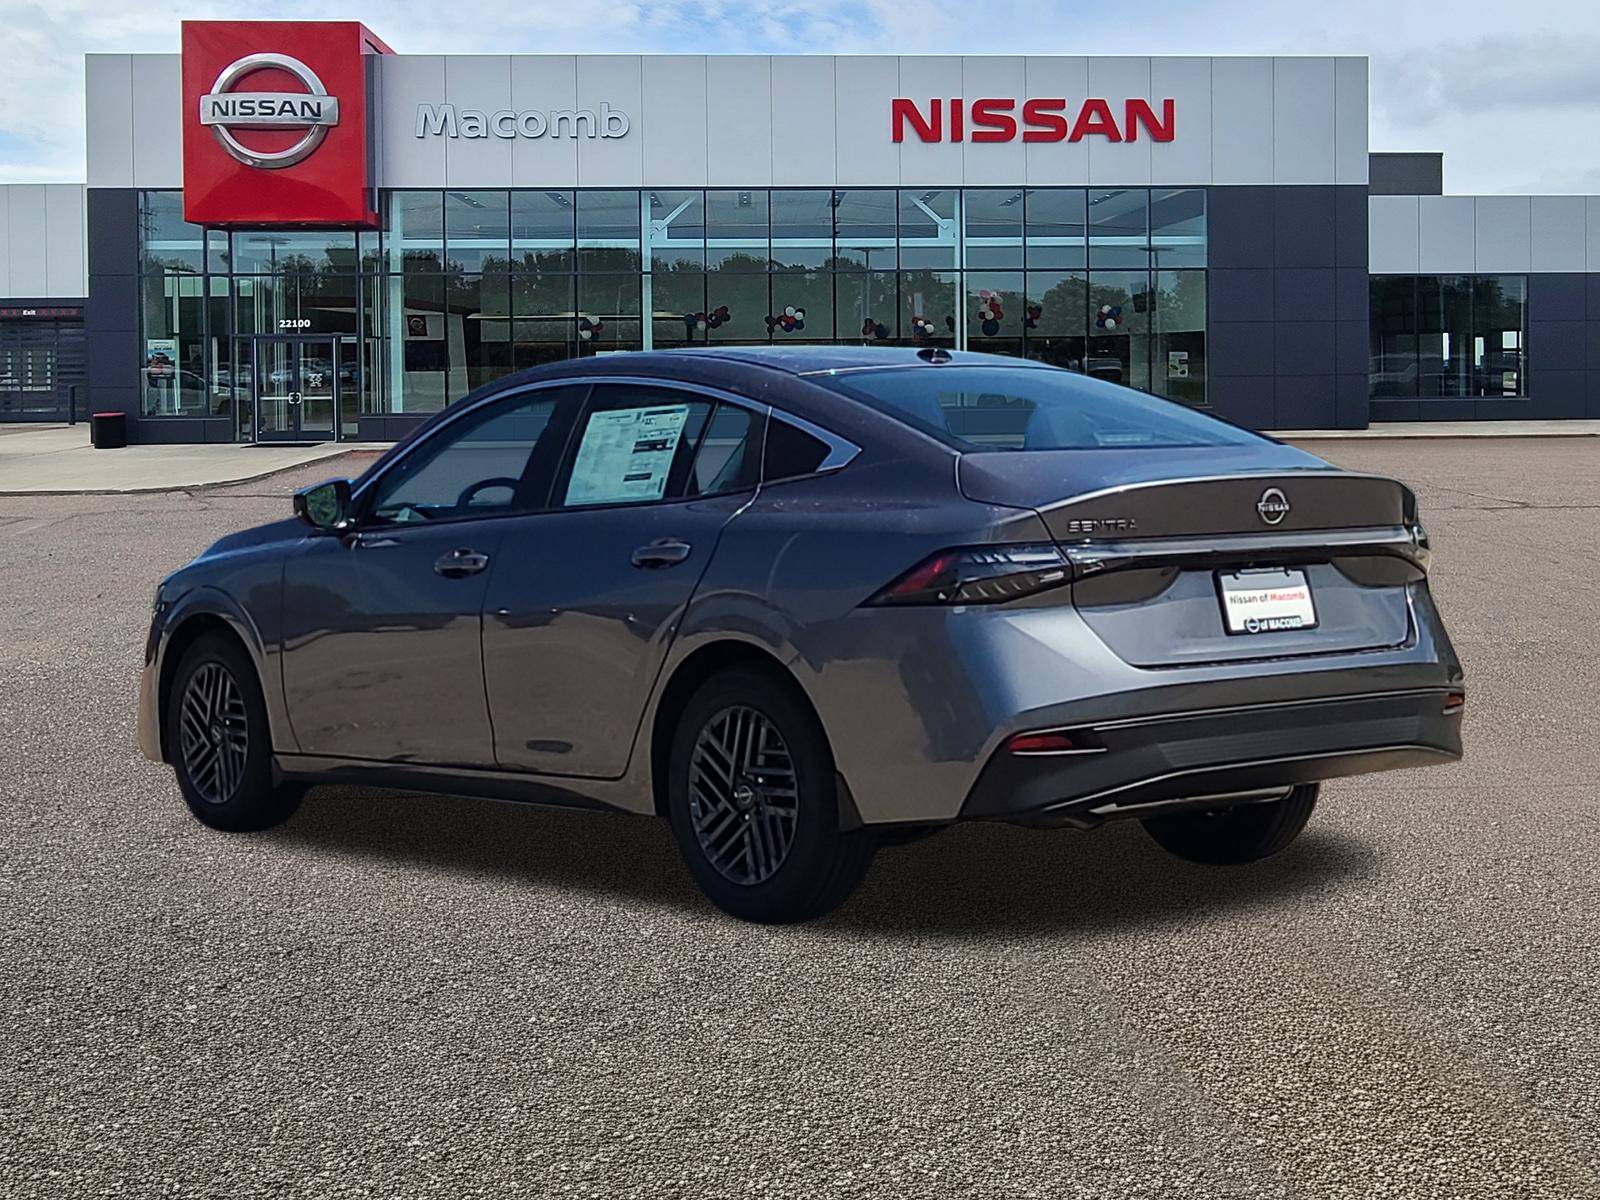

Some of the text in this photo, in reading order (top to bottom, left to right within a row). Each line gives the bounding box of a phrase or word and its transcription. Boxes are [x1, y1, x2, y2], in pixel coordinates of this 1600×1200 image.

[211, 100, 322, 118] NISSAN
[415, 101, 630, 139] Macomb
[891, 98, 1175, 143] NISSAN
[279, 319, 311, 328] 22100
[1068, 519, 1137, 533] SENTRA
[1230, 592, 1305, 604] Nissan of Macomb
